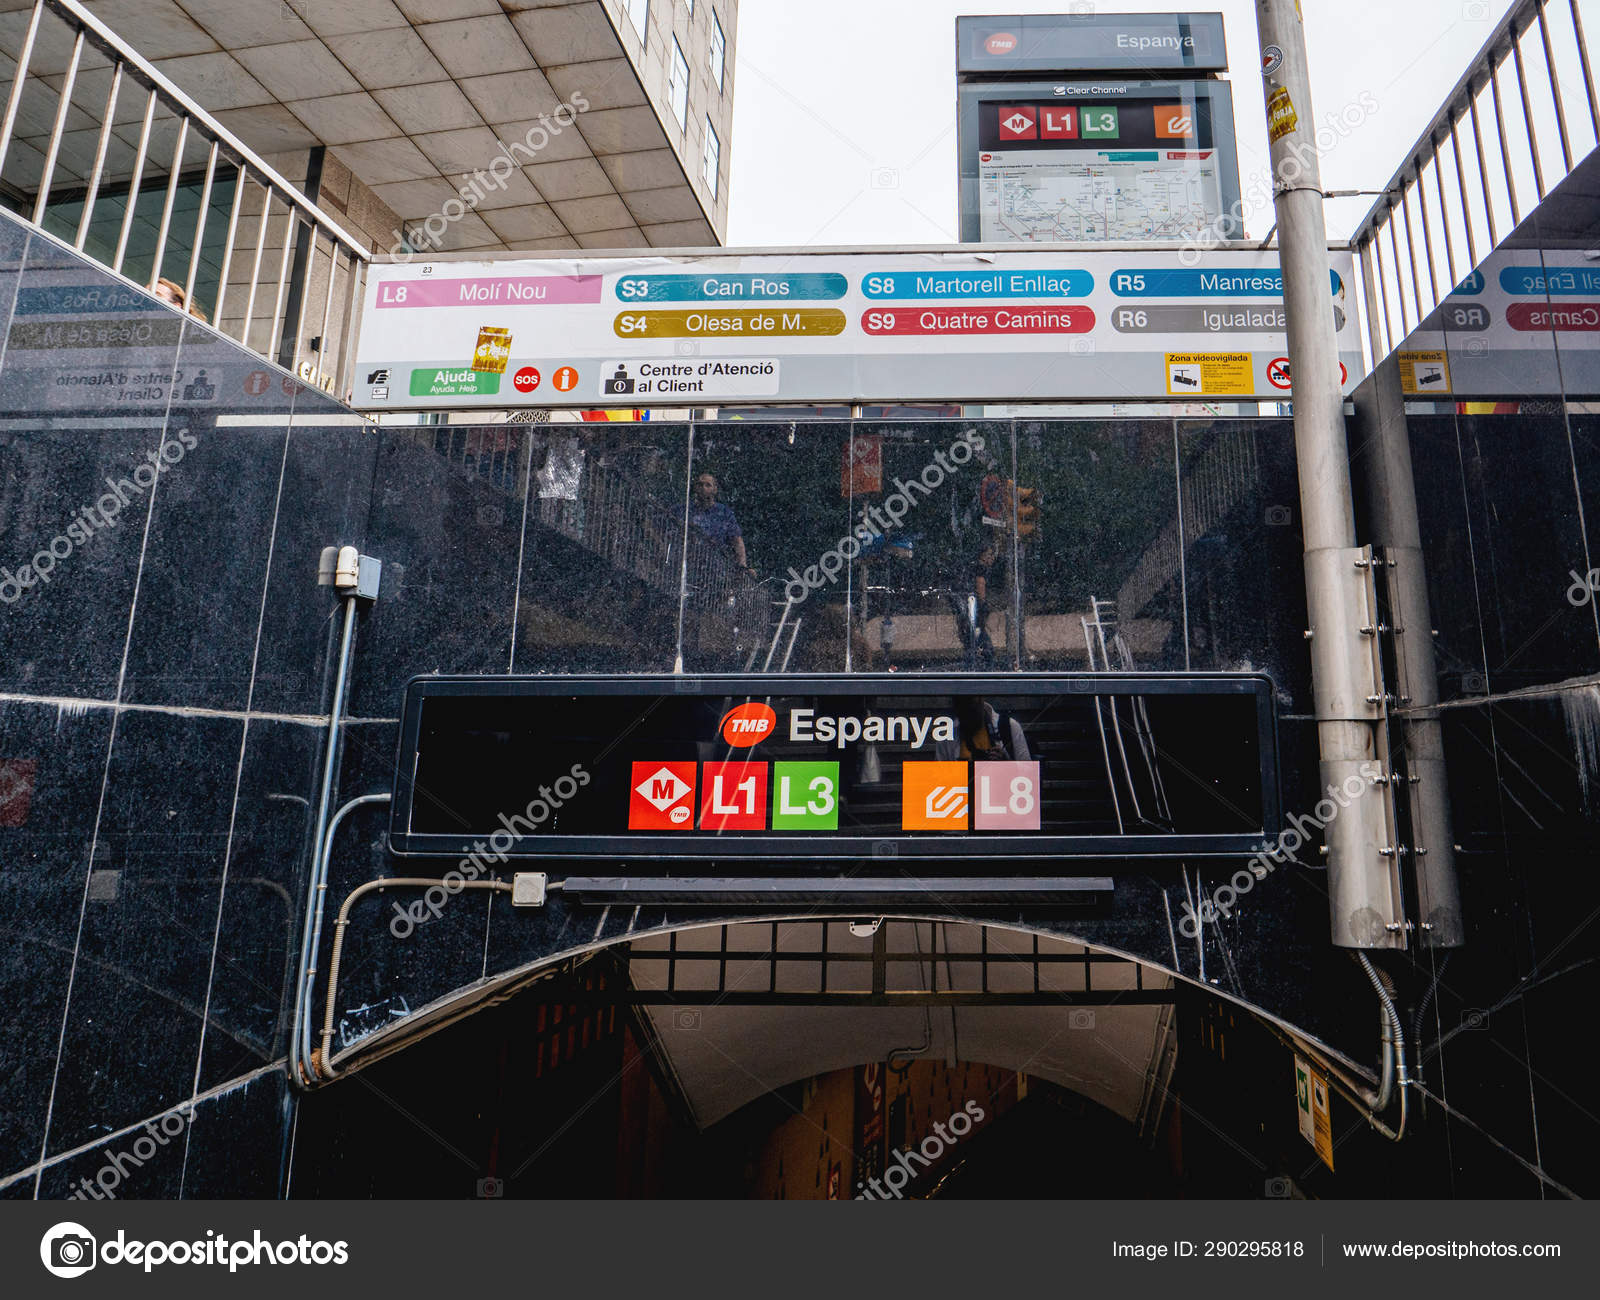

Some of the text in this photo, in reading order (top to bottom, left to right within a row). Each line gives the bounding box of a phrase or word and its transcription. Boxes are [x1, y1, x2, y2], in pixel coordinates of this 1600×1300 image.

[991, 39, 1014, 49] TMB
[1116, 34, 1195, 50] Espanya
[1066, 85, 1128, 95] Clear Channel
[1046, 113, 1116, 131] L1 L3
[422, 266, 433, 274] 23
[621, 278, 790, 298] S3 Can Ros
[867, 275, 1071, 297] S8 Martorell Enllaç
[1117, 274, 1283, 292] R5 Manresa
[382, 282, 547, 303] L8 Molí Nou
[620, 313, 806, 334] S4 Olesa de M.
[867, 310, 1072, 331] S9 Quatre Camins
[1118, 309, 1286, 331] R6 Igualada
[1169, 353, 1248, 363] Zona videovigilada
[434, 371, 476, 384] Ajuda
[639, 362, 693, 377] Centre
[515, 375, 539, 385] SOS
[638, 379, 704, 393] al Client
[430, 385, 477, 394] Ayuda Help
[731, 719, 768, 733] TMB
[789, 708, 954, 749] Espanya
[713, 776, 835, 816] L1 L3
[980, 776, 1034, 816] L8
